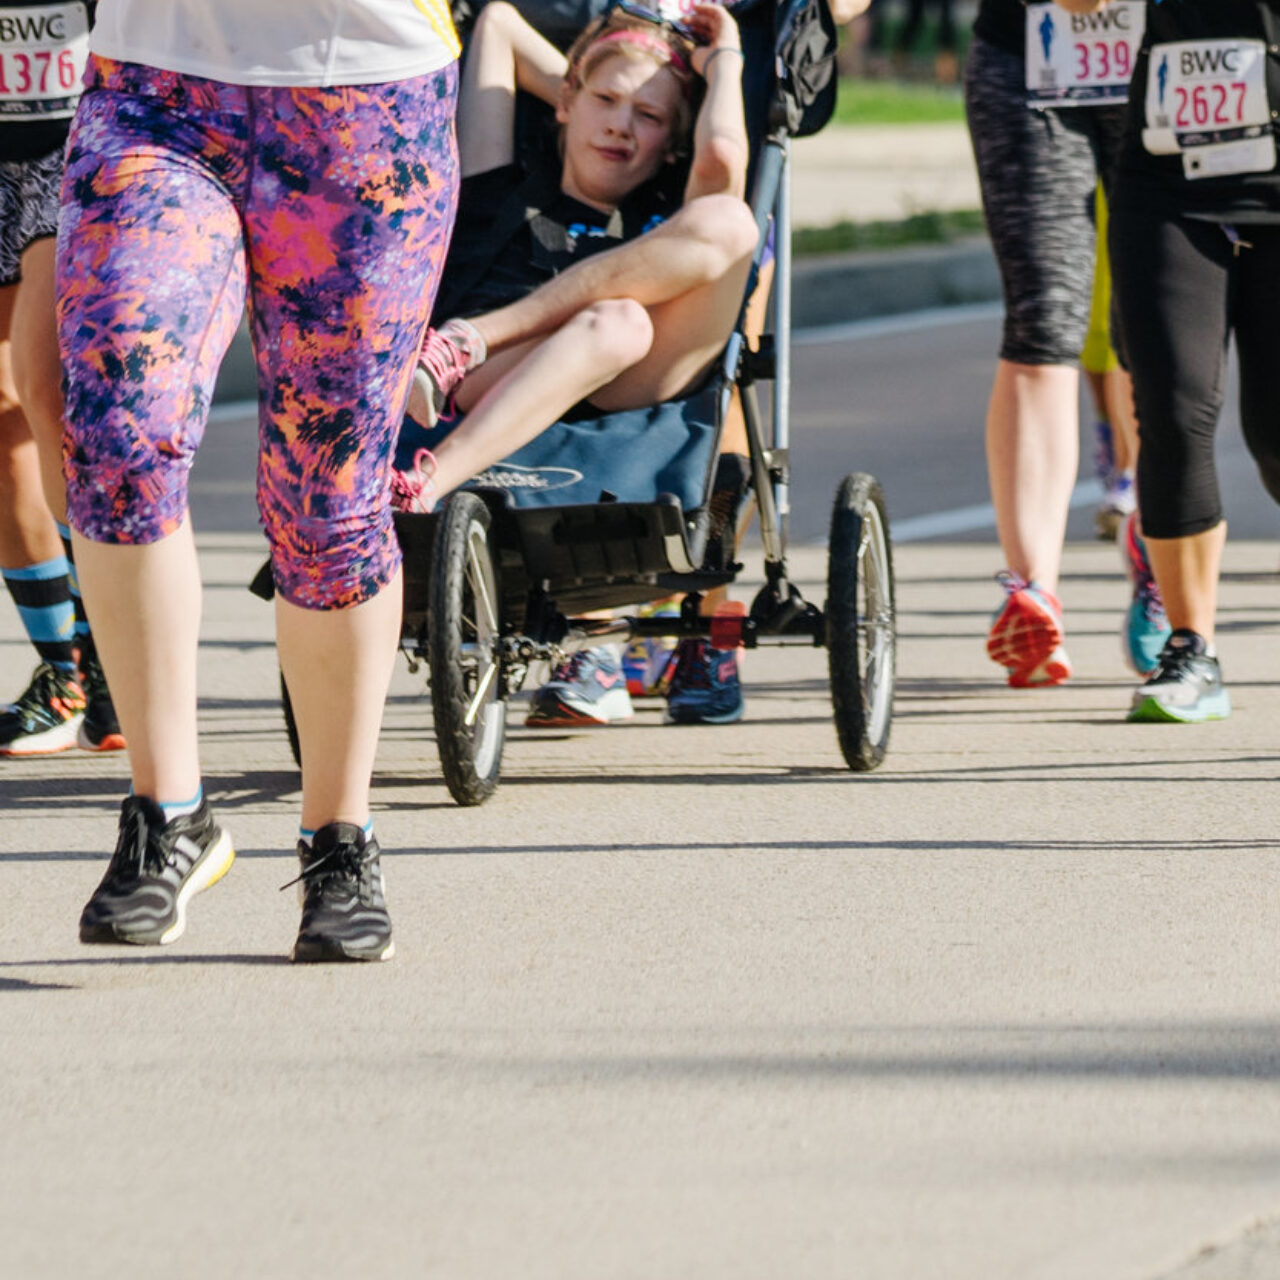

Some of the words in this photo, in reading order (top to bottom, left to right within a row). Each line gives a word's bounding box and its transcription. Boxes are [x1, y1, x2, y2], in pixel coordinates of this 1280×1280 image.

[0, 14, 65, 41] BWC
[1072, 6, 1130, 33] BWC
[0, 50, 75, 94] 1376
[1074, 41, 1130, 80] 339
[1181, 48, 1239, 75] BWC
[1175, 82, 1247, 126] 2627
